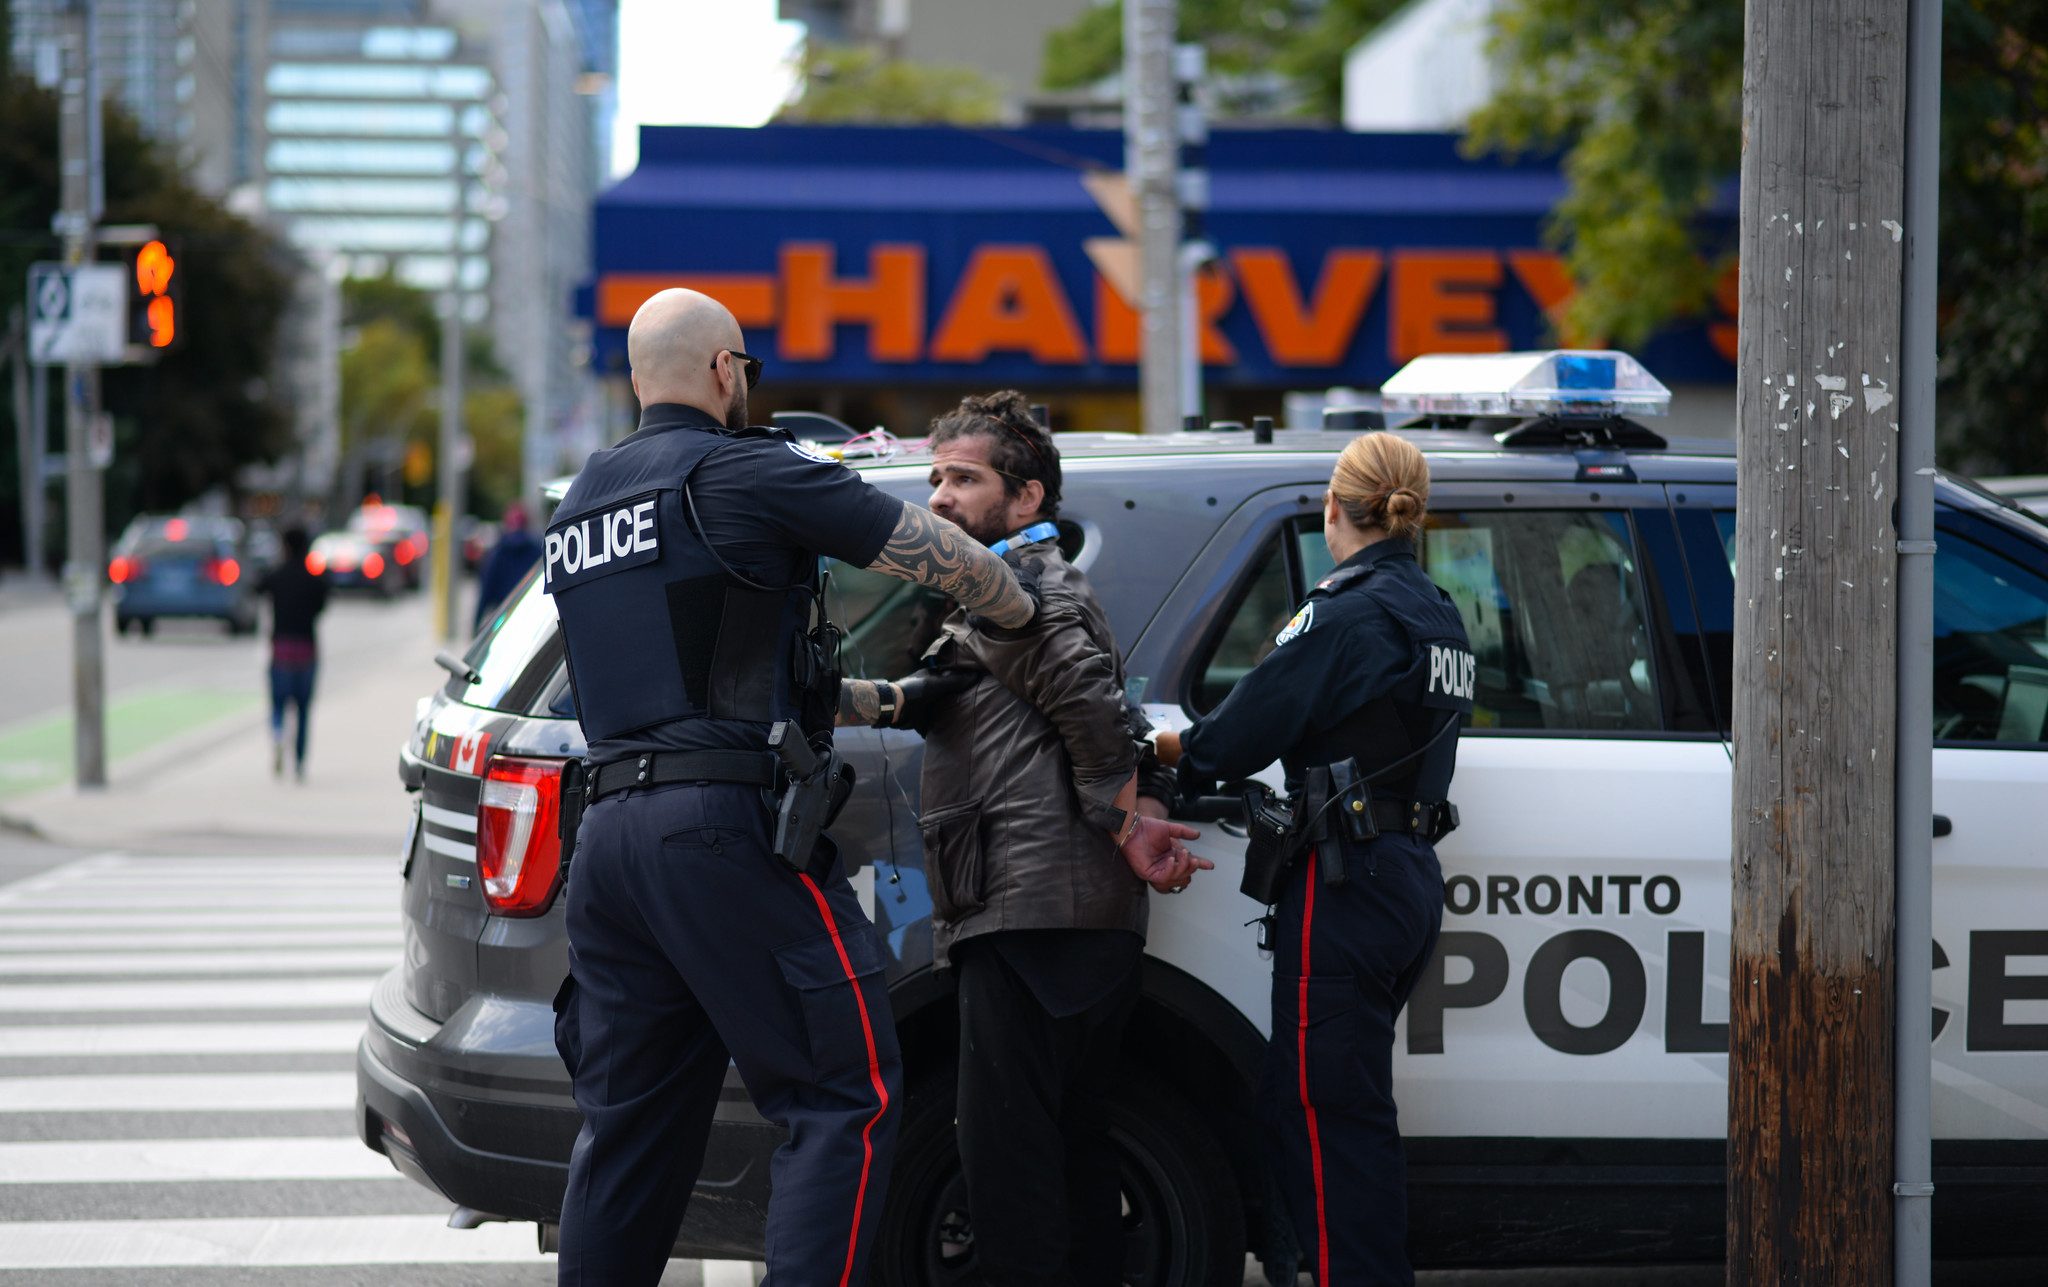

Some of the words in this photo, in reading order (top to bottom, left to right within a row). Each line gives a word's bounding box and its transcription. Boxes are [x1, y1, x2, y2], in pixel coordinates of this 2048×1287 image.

[544, 500, 657, 584] POLICE
[1443, 874, 1681, 916] ORONTO
[1407, 928, 2048, 1055] POLE
